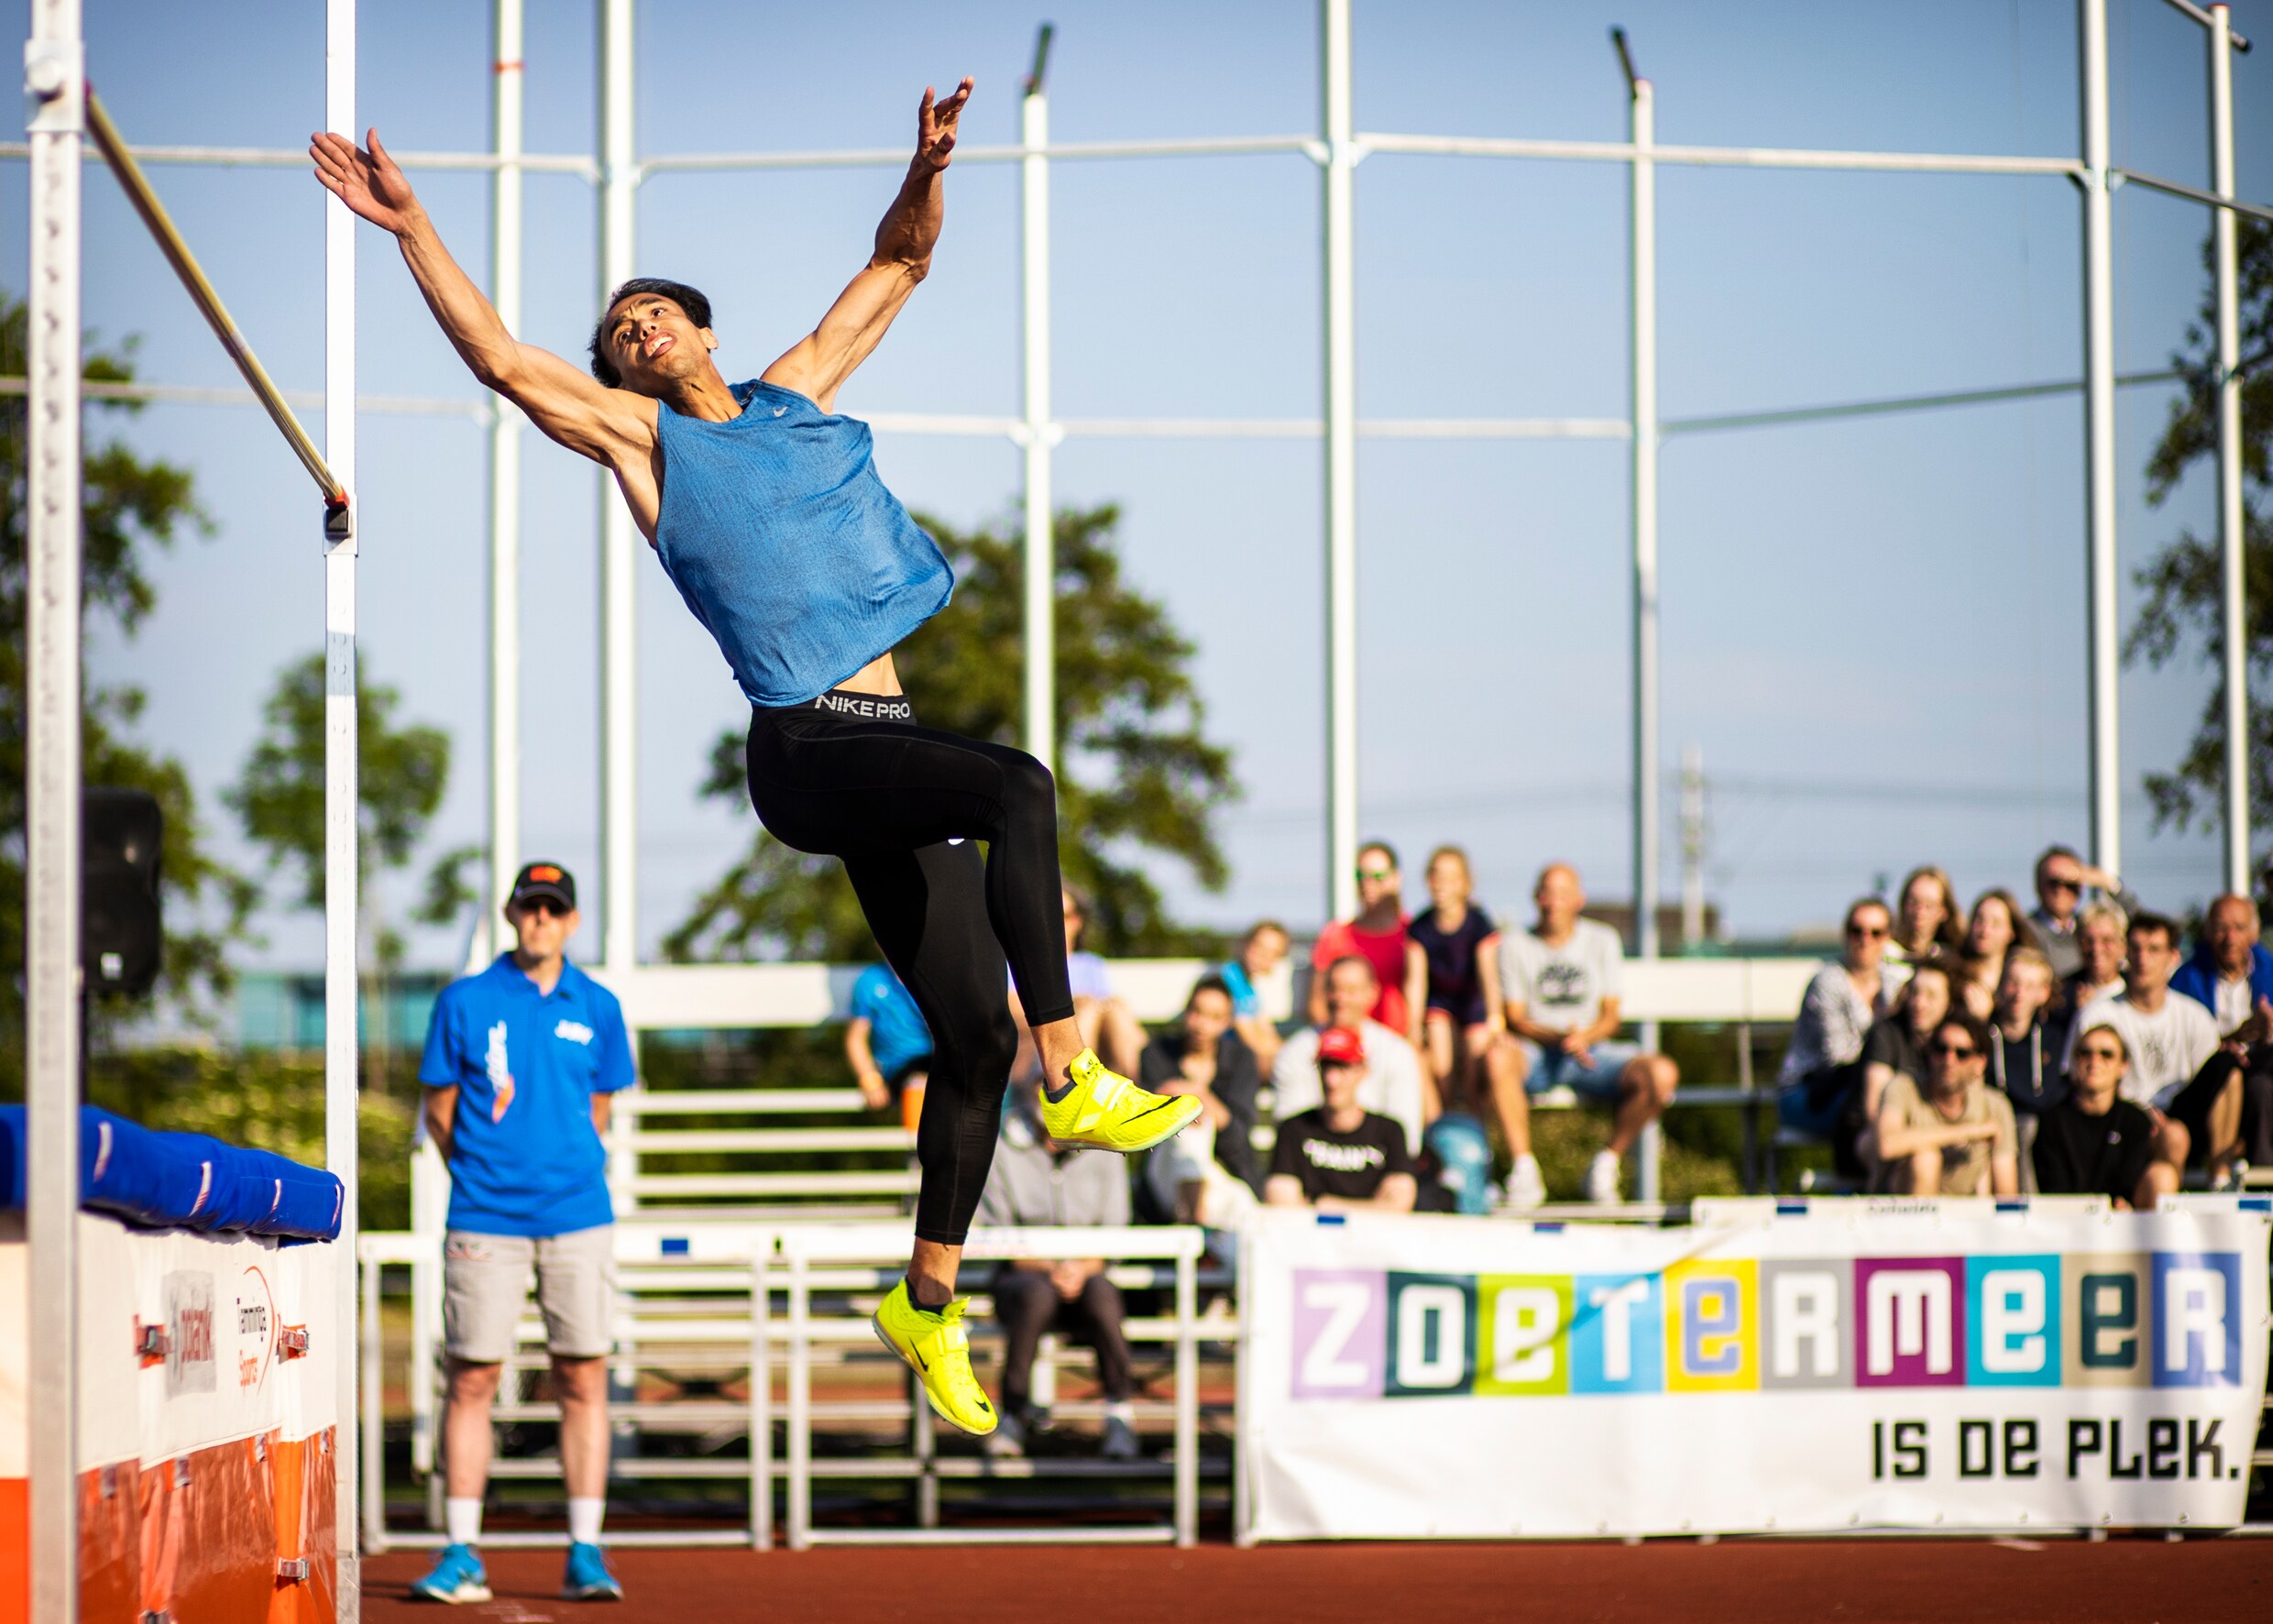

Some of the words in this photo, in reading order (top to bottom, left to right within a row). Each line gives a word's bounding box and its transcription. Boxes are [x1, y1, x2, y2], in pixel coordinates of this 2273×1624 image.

[815, 694, 874, 717] NIKE
[876, 702, 910, 719] PRO
[1872, 1418, 1928, 1480] IS
